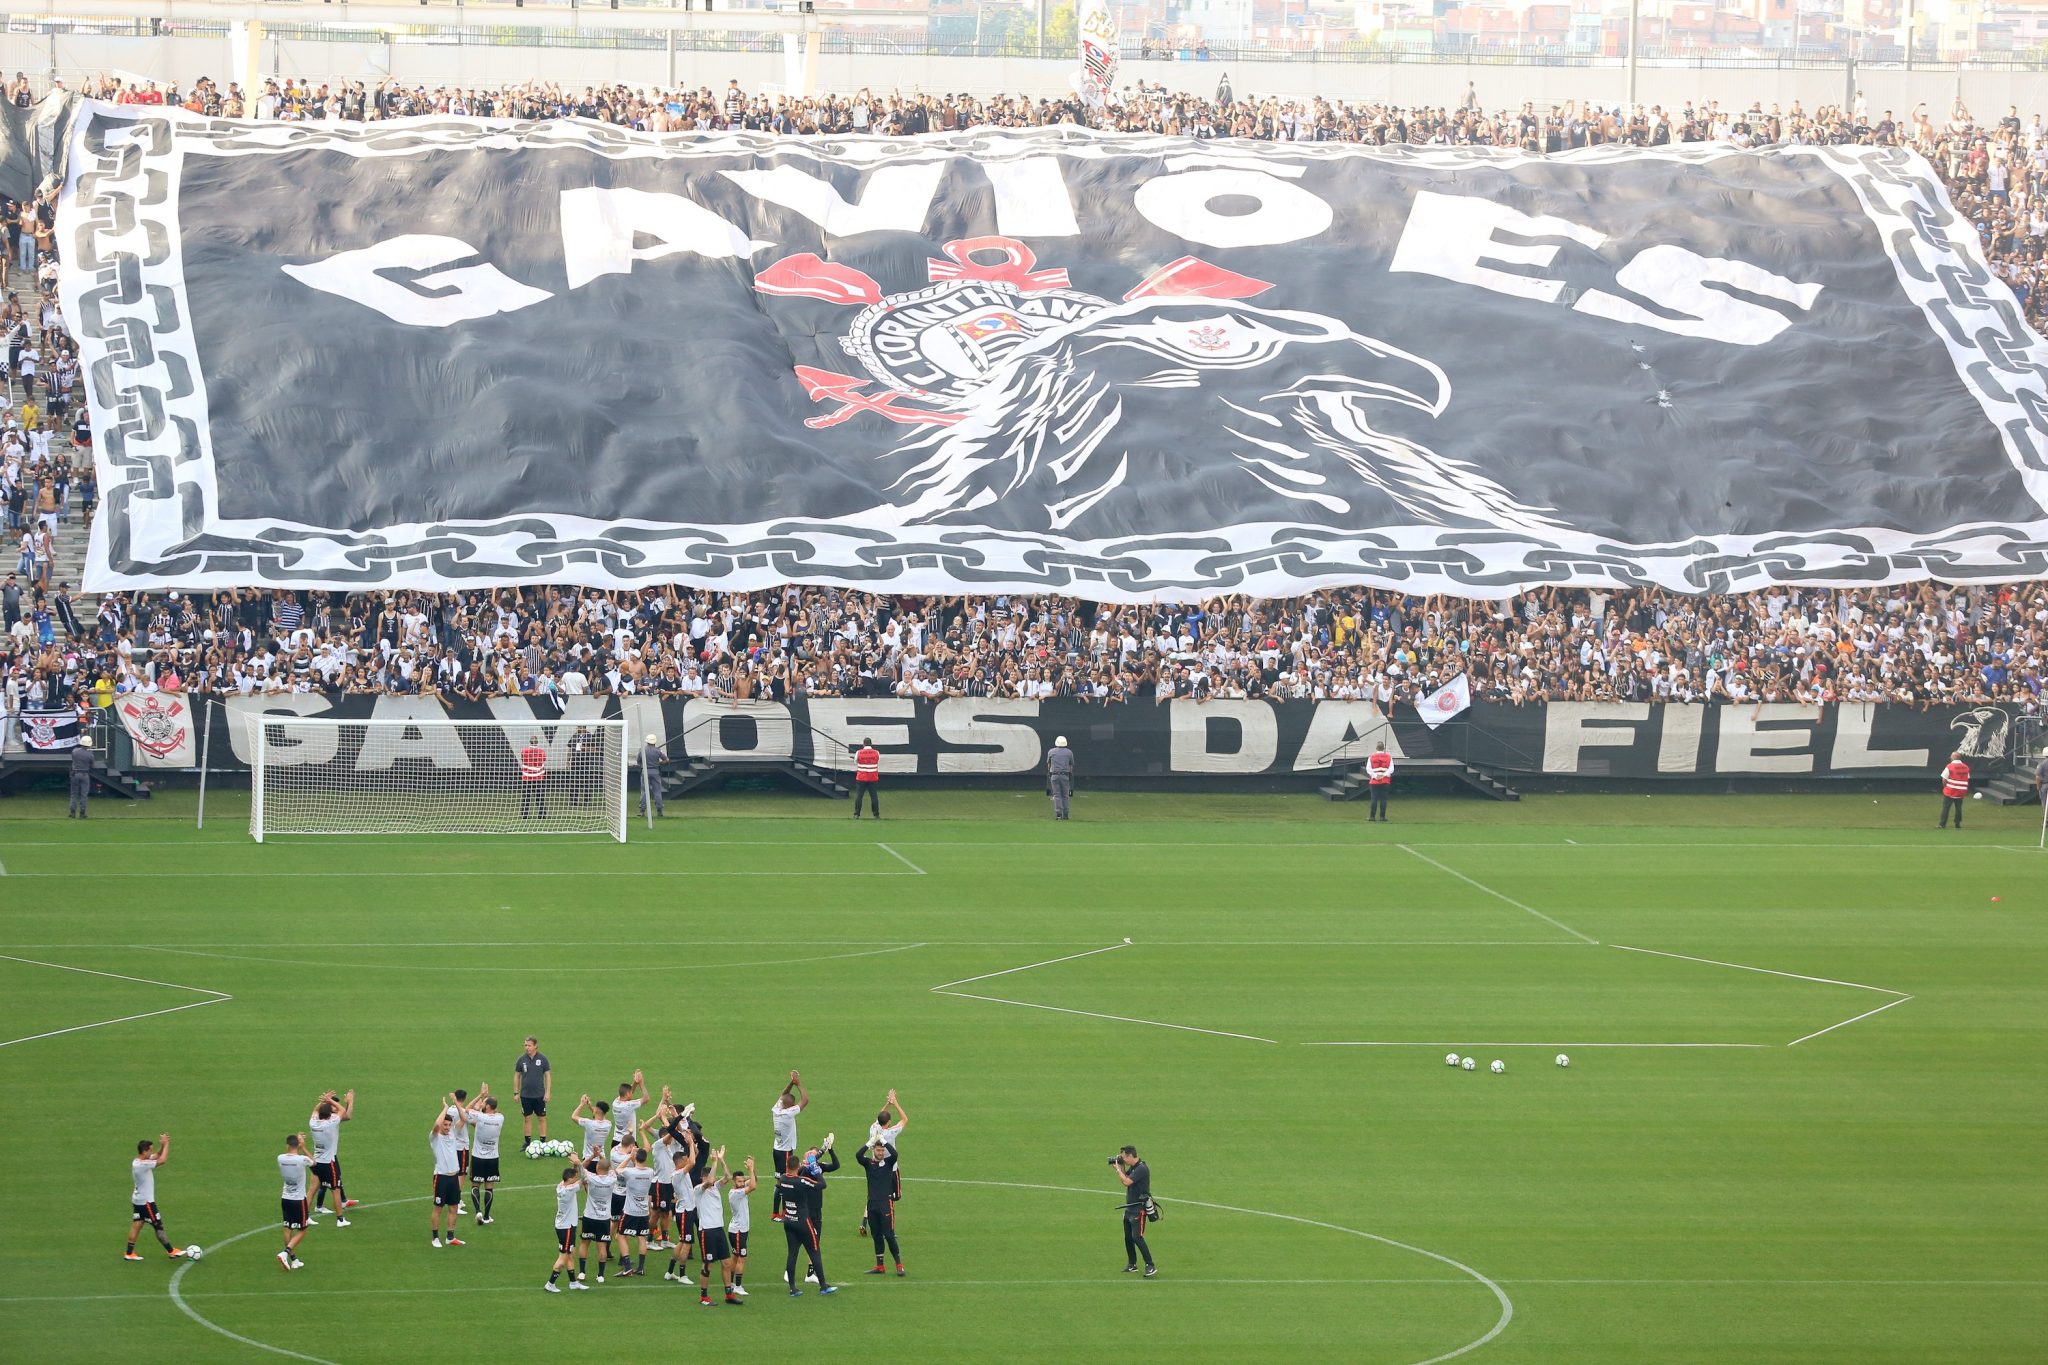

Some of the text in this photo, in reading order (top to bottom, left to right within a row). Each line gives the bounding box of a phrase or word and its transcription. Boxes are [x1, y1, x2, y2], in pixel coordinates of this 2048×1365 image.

[282, 155, 1822, 346] GAVIÕES
[1168, 698, 1411, 774] DA
[1543, 700, 1929, 774] FIEL
